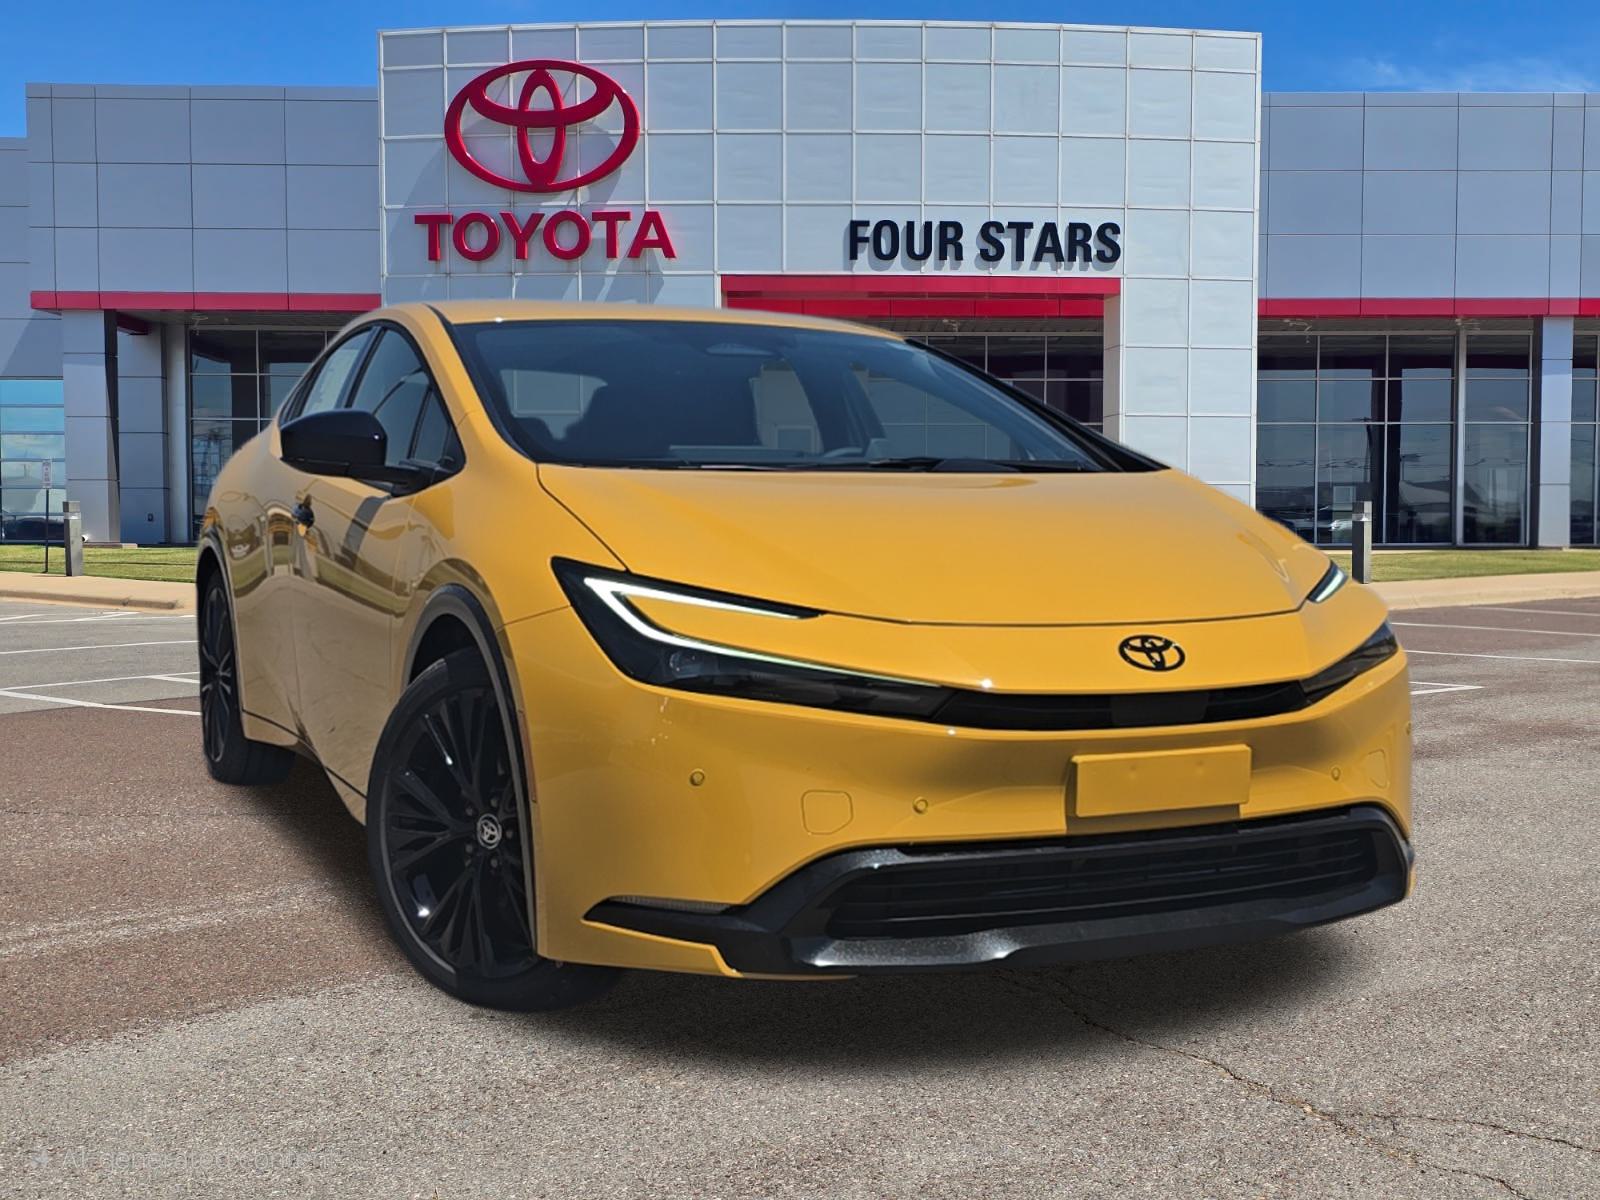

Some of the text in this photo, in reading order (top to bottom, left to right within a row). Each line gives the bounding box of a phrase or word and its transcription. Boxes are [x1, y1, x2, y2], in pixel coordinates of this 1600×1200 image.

[414, 211, 677, 262] TOYOTA
[848, 220, 1122, 264] FOUR STARS
